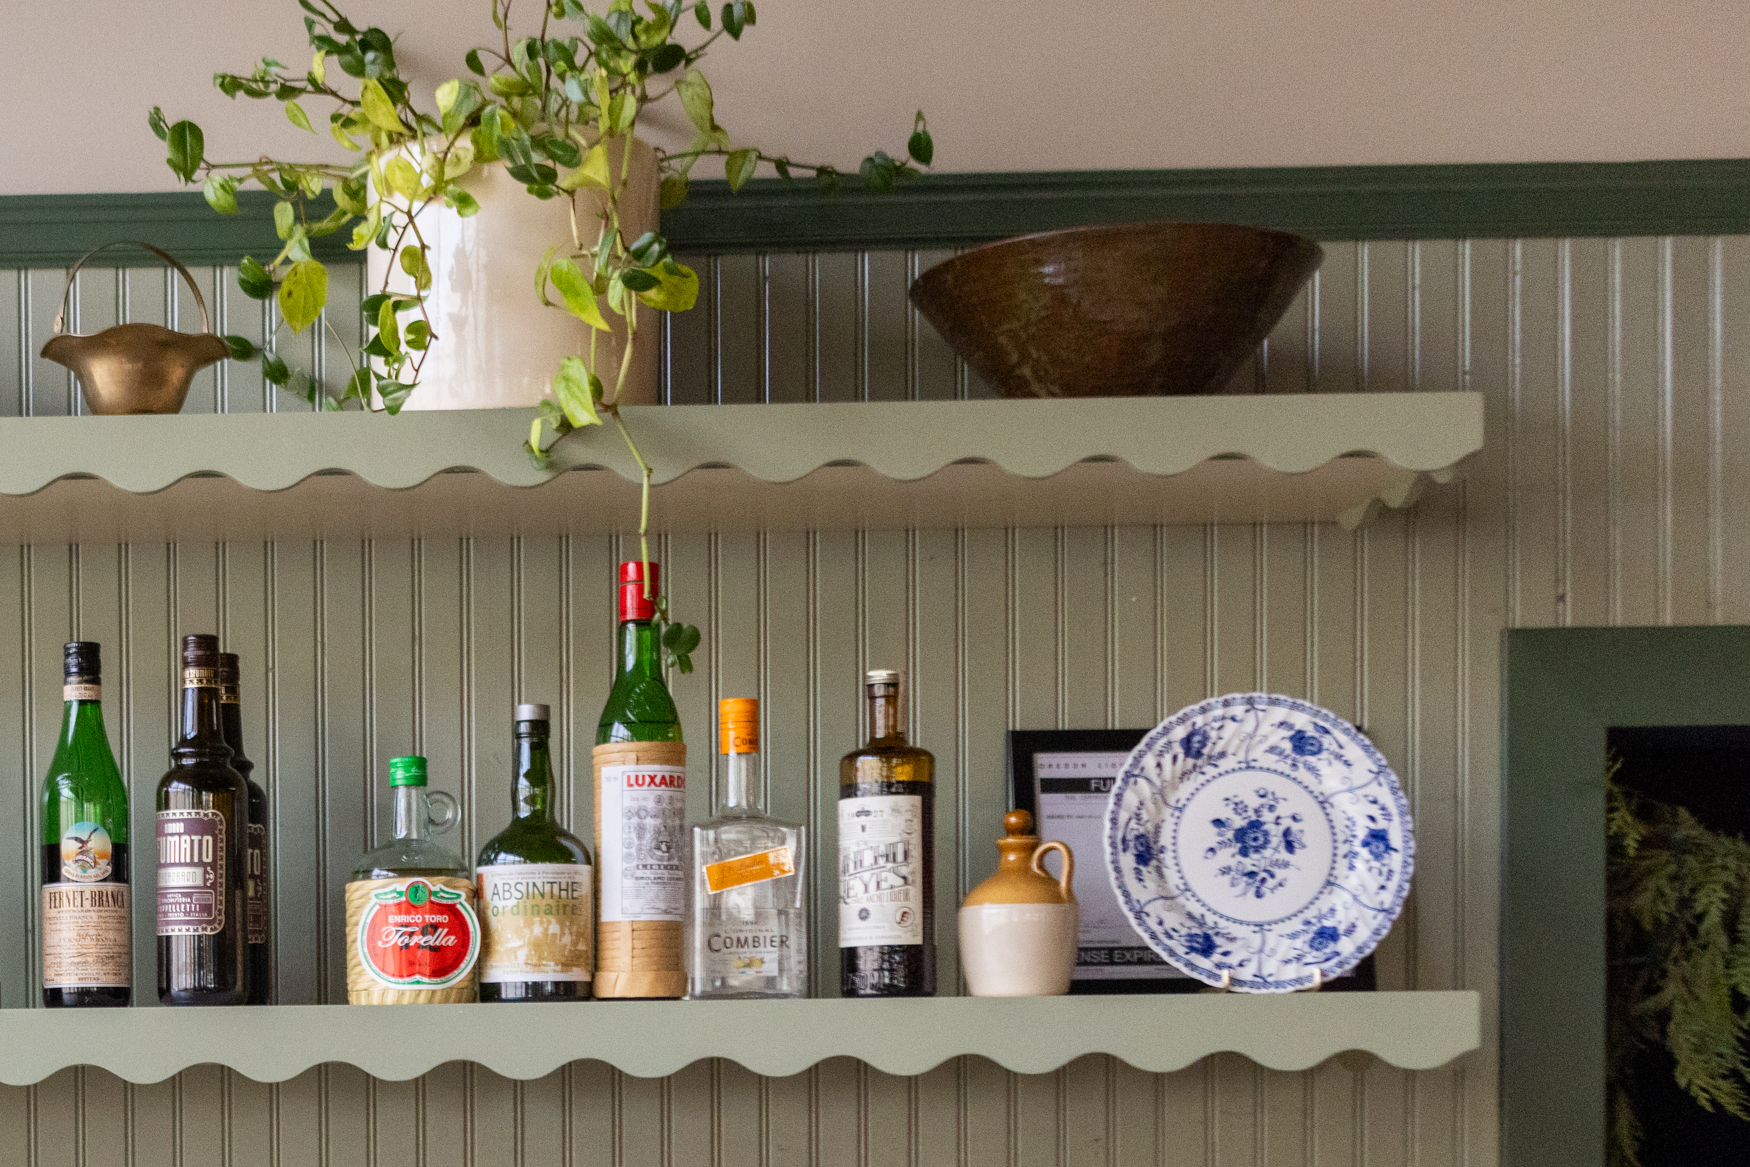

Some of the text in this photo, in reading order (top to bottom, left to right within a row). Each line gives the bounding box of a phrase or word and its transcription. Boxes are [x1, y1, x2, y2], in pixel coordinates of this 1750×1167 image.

[49, 890, 125, 910] FERNET-BRANCA
[490, 881, 578, 901] ABSINTHE
[388, 914, 449, 923] ENRICO TORO
[491, 901, 577, 917] ordinaire
[377, 926, 458, 948] Torella
[707, 934, 790, 952] COMBIER
